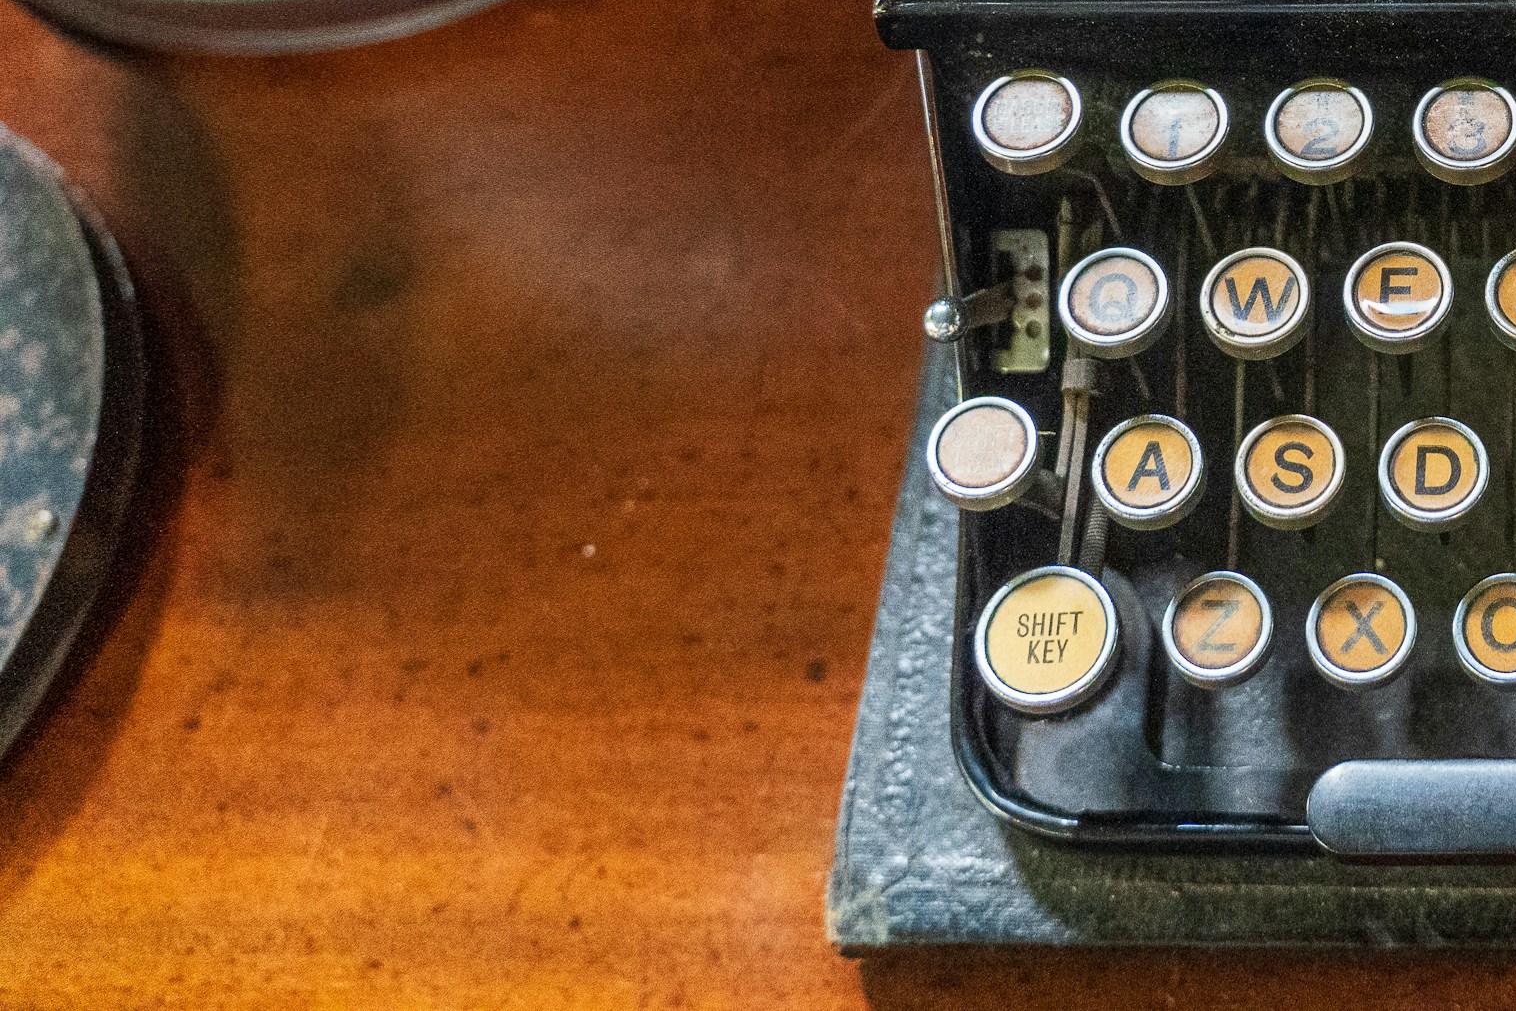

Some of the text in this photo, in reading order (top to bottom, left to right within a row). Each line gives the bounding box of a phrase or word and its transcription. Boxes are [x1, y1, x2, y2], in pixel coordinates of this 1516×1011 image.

[1300, 117, 1340, 155] 2
[1448, 117, 1488, 156] 3
[1088, 271, 1140, 325] Q
[1223, 274, 1298, 325] W
[1377, 265, 1420, 317] E
[1125, 439, 1173, 492] A
[1269, 440, 1315, 494] S
[1413, 444, 1463, 496] D
[1015, 609, 1085, 640] SHIFT
[1198, 598, 1241, 653] Z
[1337, 599, 1390, 656] X
[1025, 638, 1070, 666] KEY
